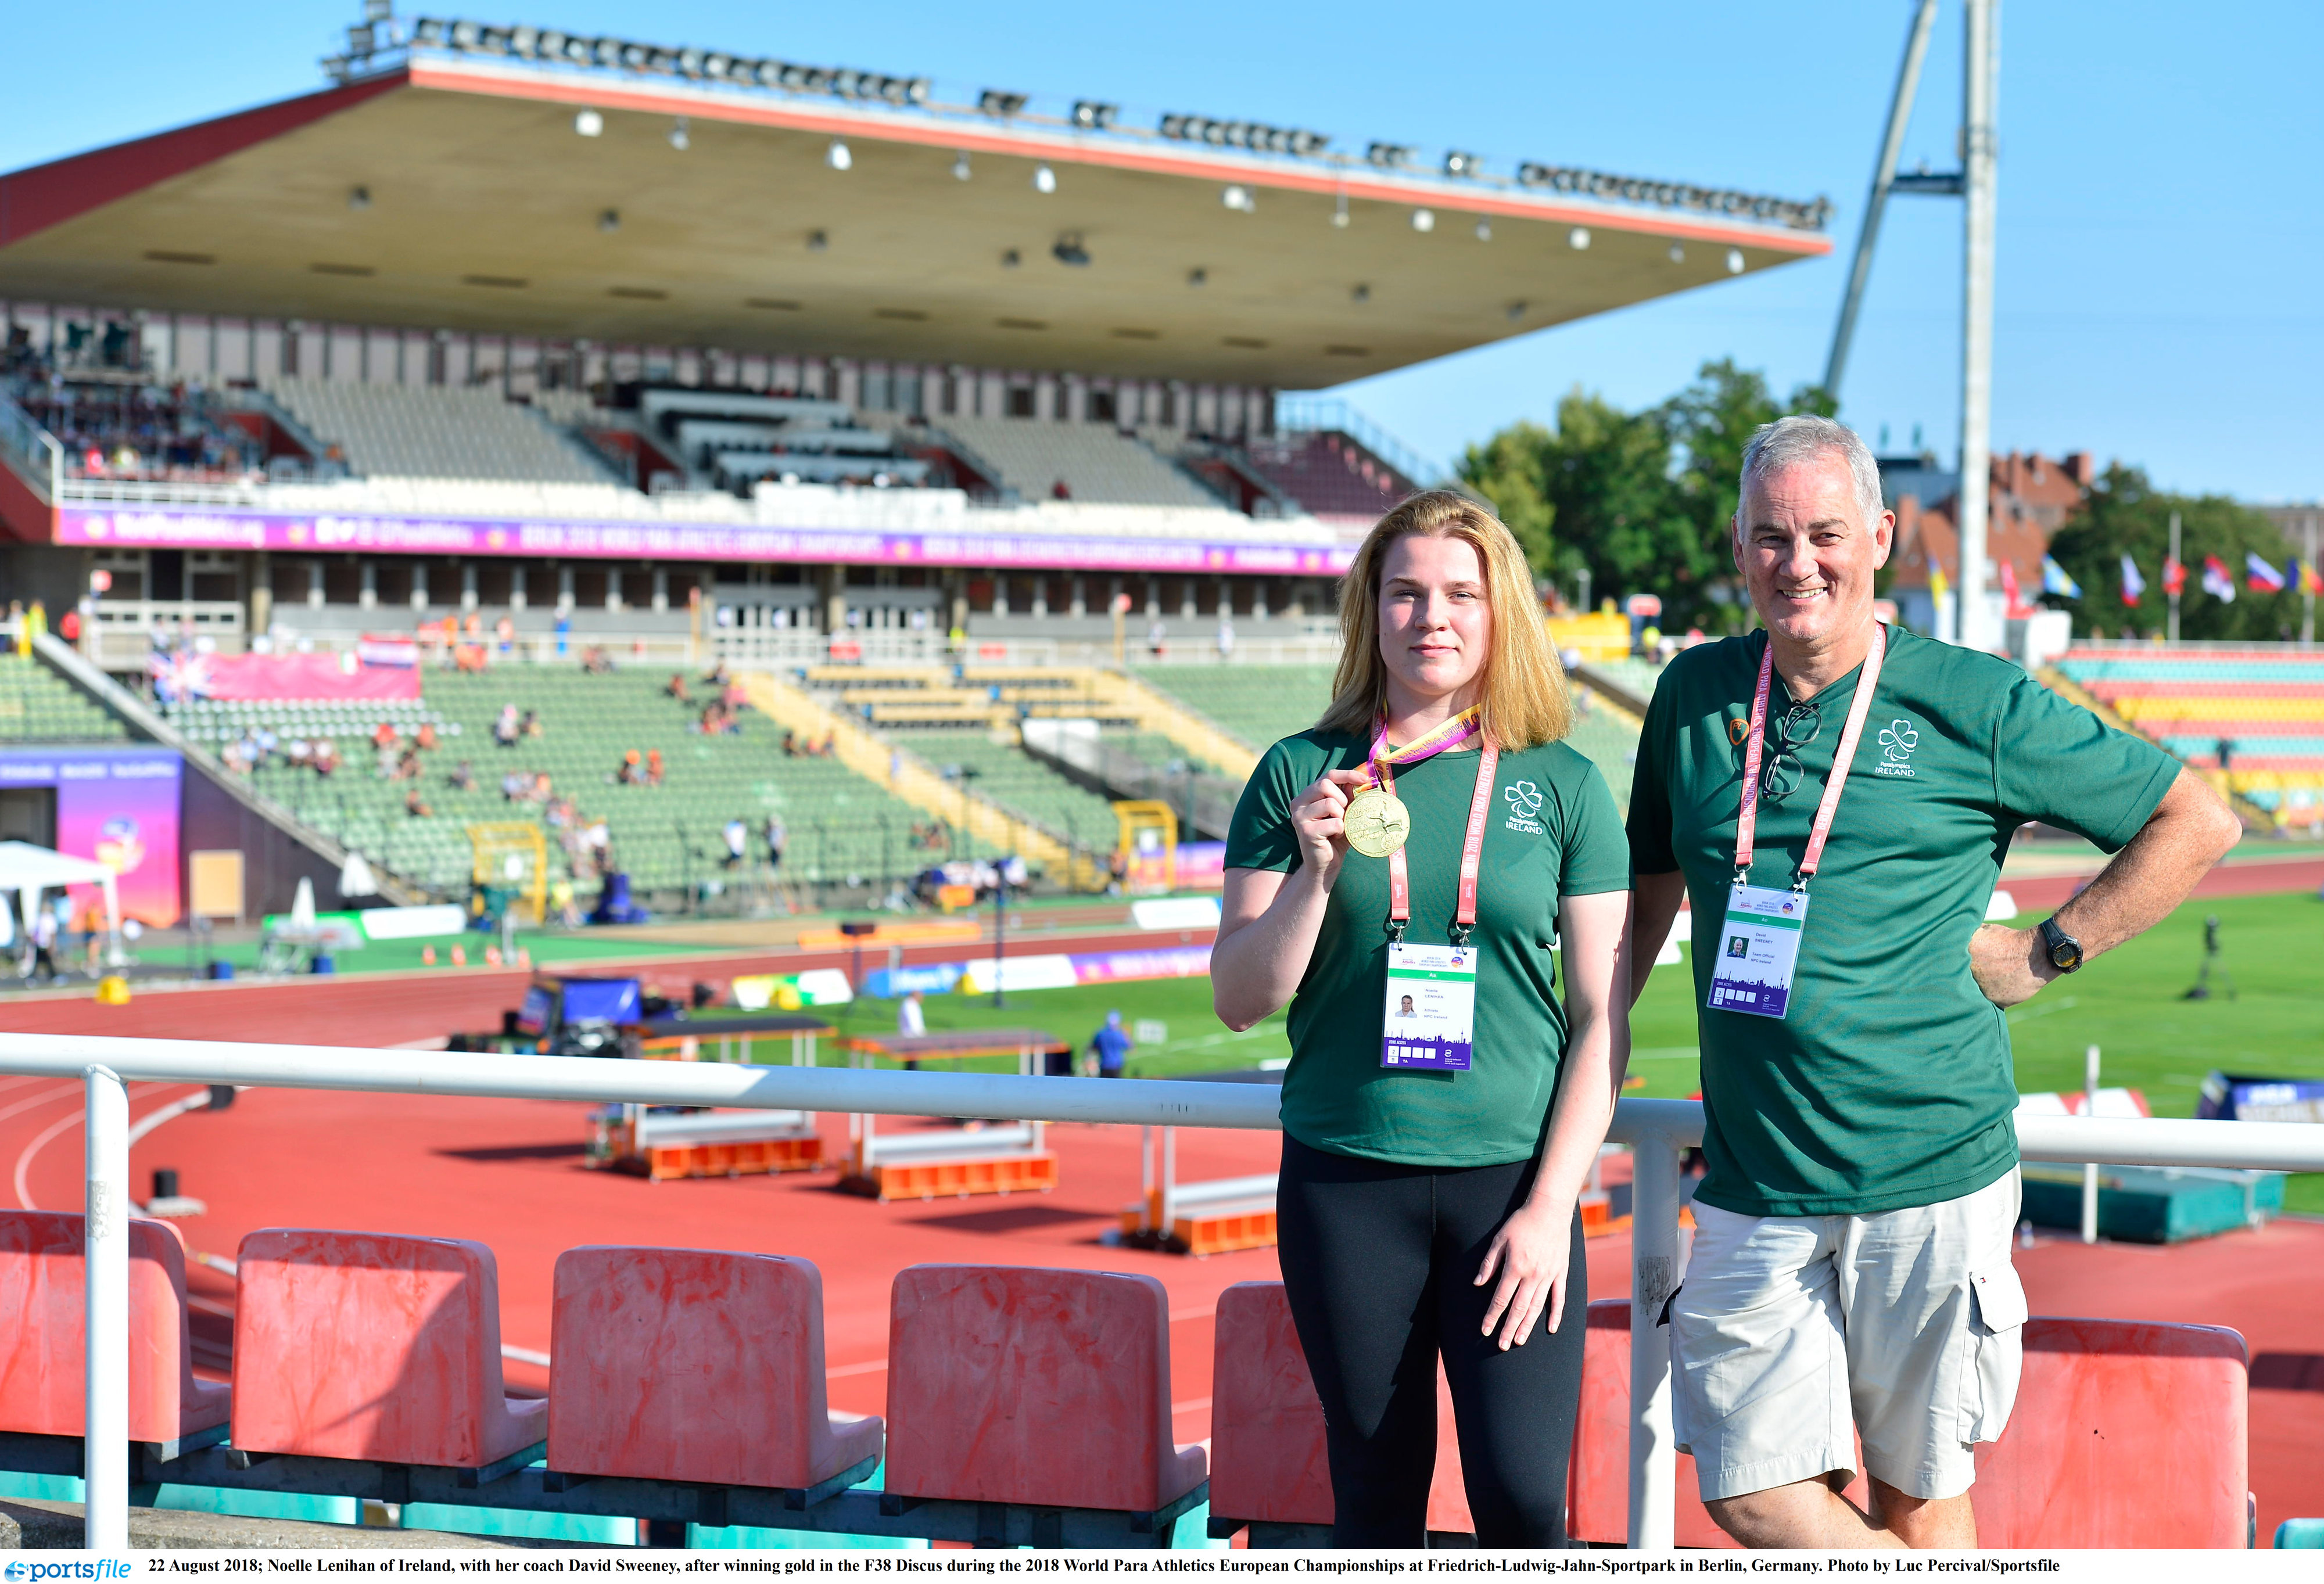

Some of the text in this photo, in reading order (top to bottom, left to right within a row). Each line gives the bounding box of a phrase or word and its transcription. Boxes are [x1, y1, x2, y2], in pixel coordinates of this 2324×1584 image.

[1442, 718, 1471, 740] EUROPEAN
[1742, 651, 1771, 821] WORLD PARA ATHLETICS EUROPEAN CHAMPIONSHIPS
[1477, 764, 1493, 796] ATHLETICS
[1875, 767, 1916, 777] IRELAND
[1474, 796, 1487, 813] PARA
[1469, 814, 1483, 835] WORLD
[1505, 821, 1543, 835] IRELAND
[1509, 816, 1538, 827] Paralympics
[1466, 837, 1479, 852] 2018
[1464, 854, 1476, 878] BERLIN
